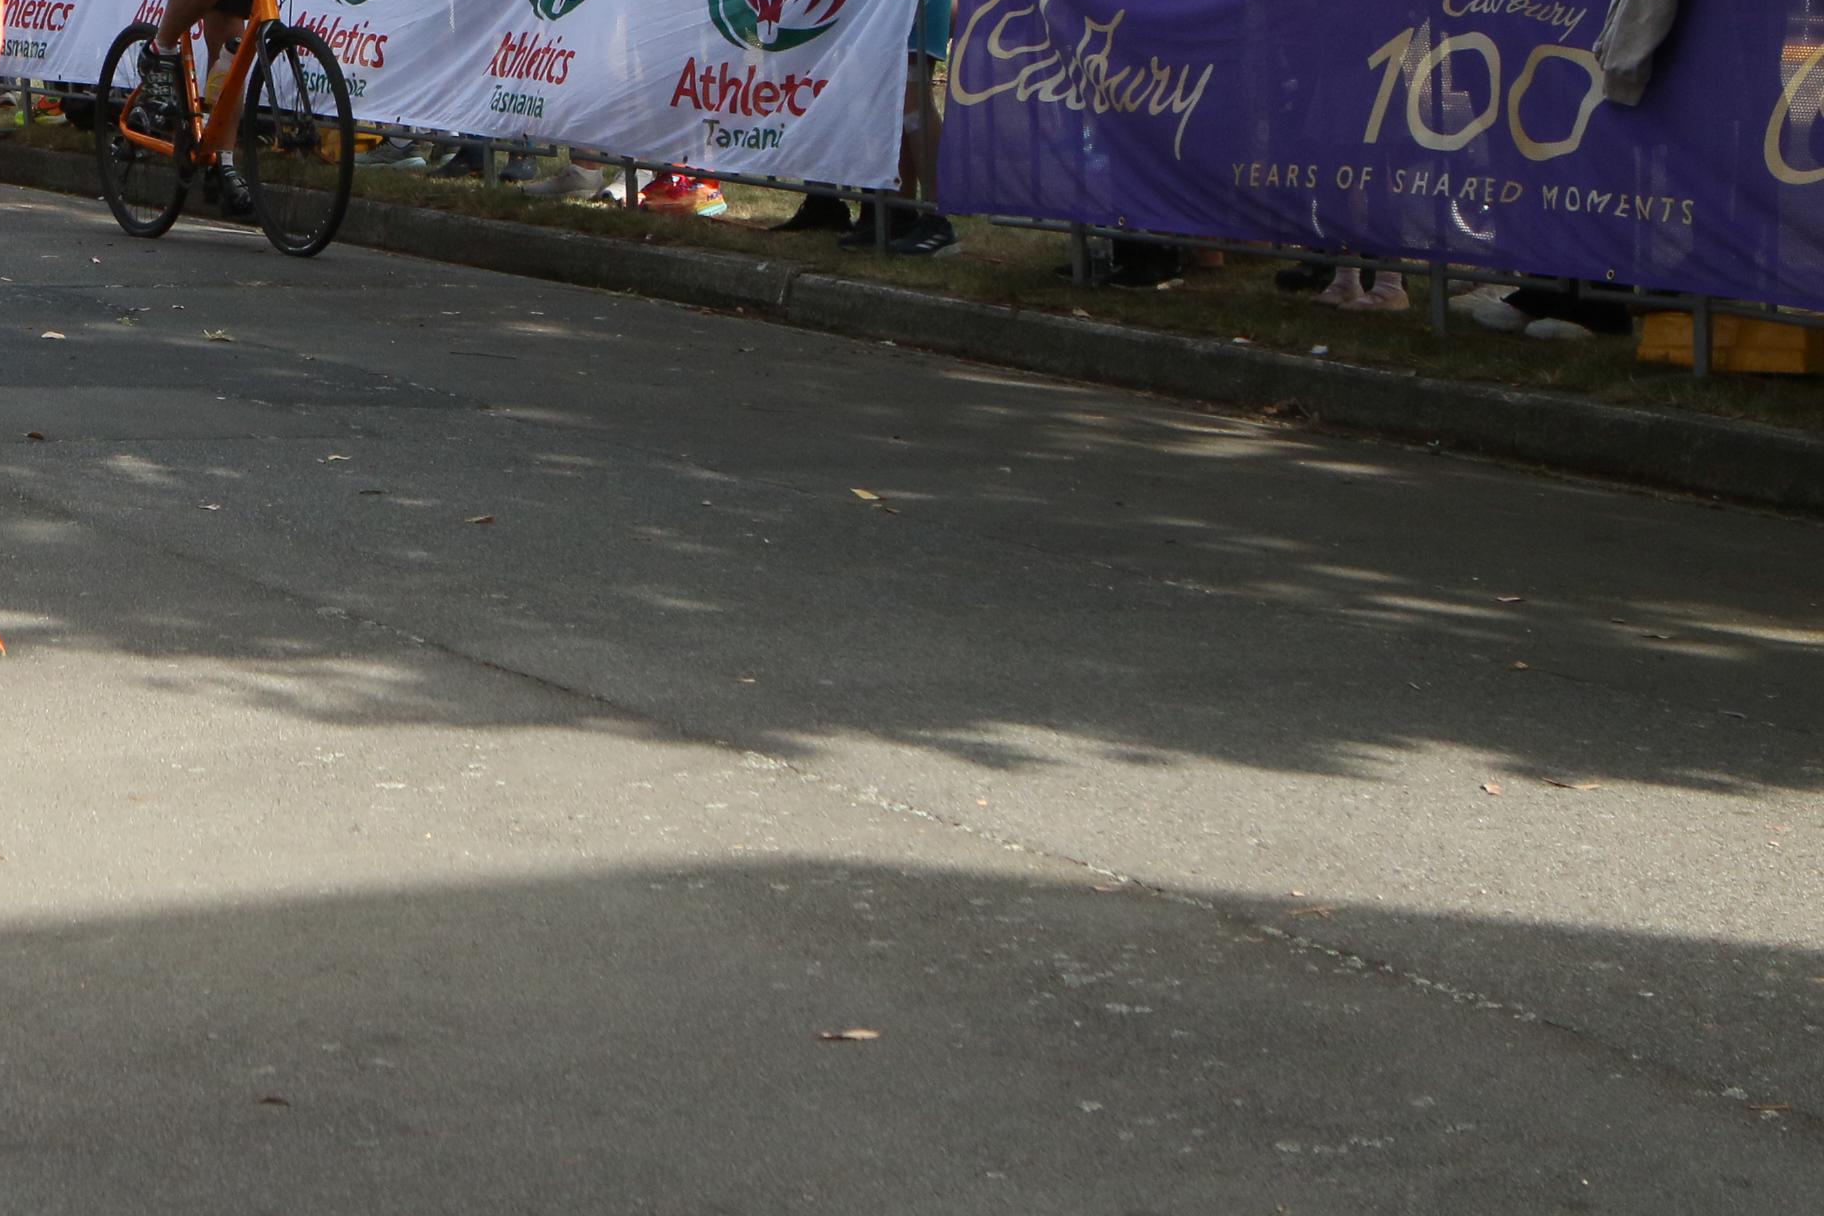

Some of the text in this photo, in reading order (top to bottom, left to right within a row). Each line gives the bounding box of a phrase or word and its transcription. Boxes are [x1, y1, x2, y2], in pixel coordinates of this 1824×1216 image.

[482, 30, 576, 85] Athletics
[1363, 27, 1608, 162] 100
[1232, 162, 1694, 226] YEARS OF SHARED MOMENTS
